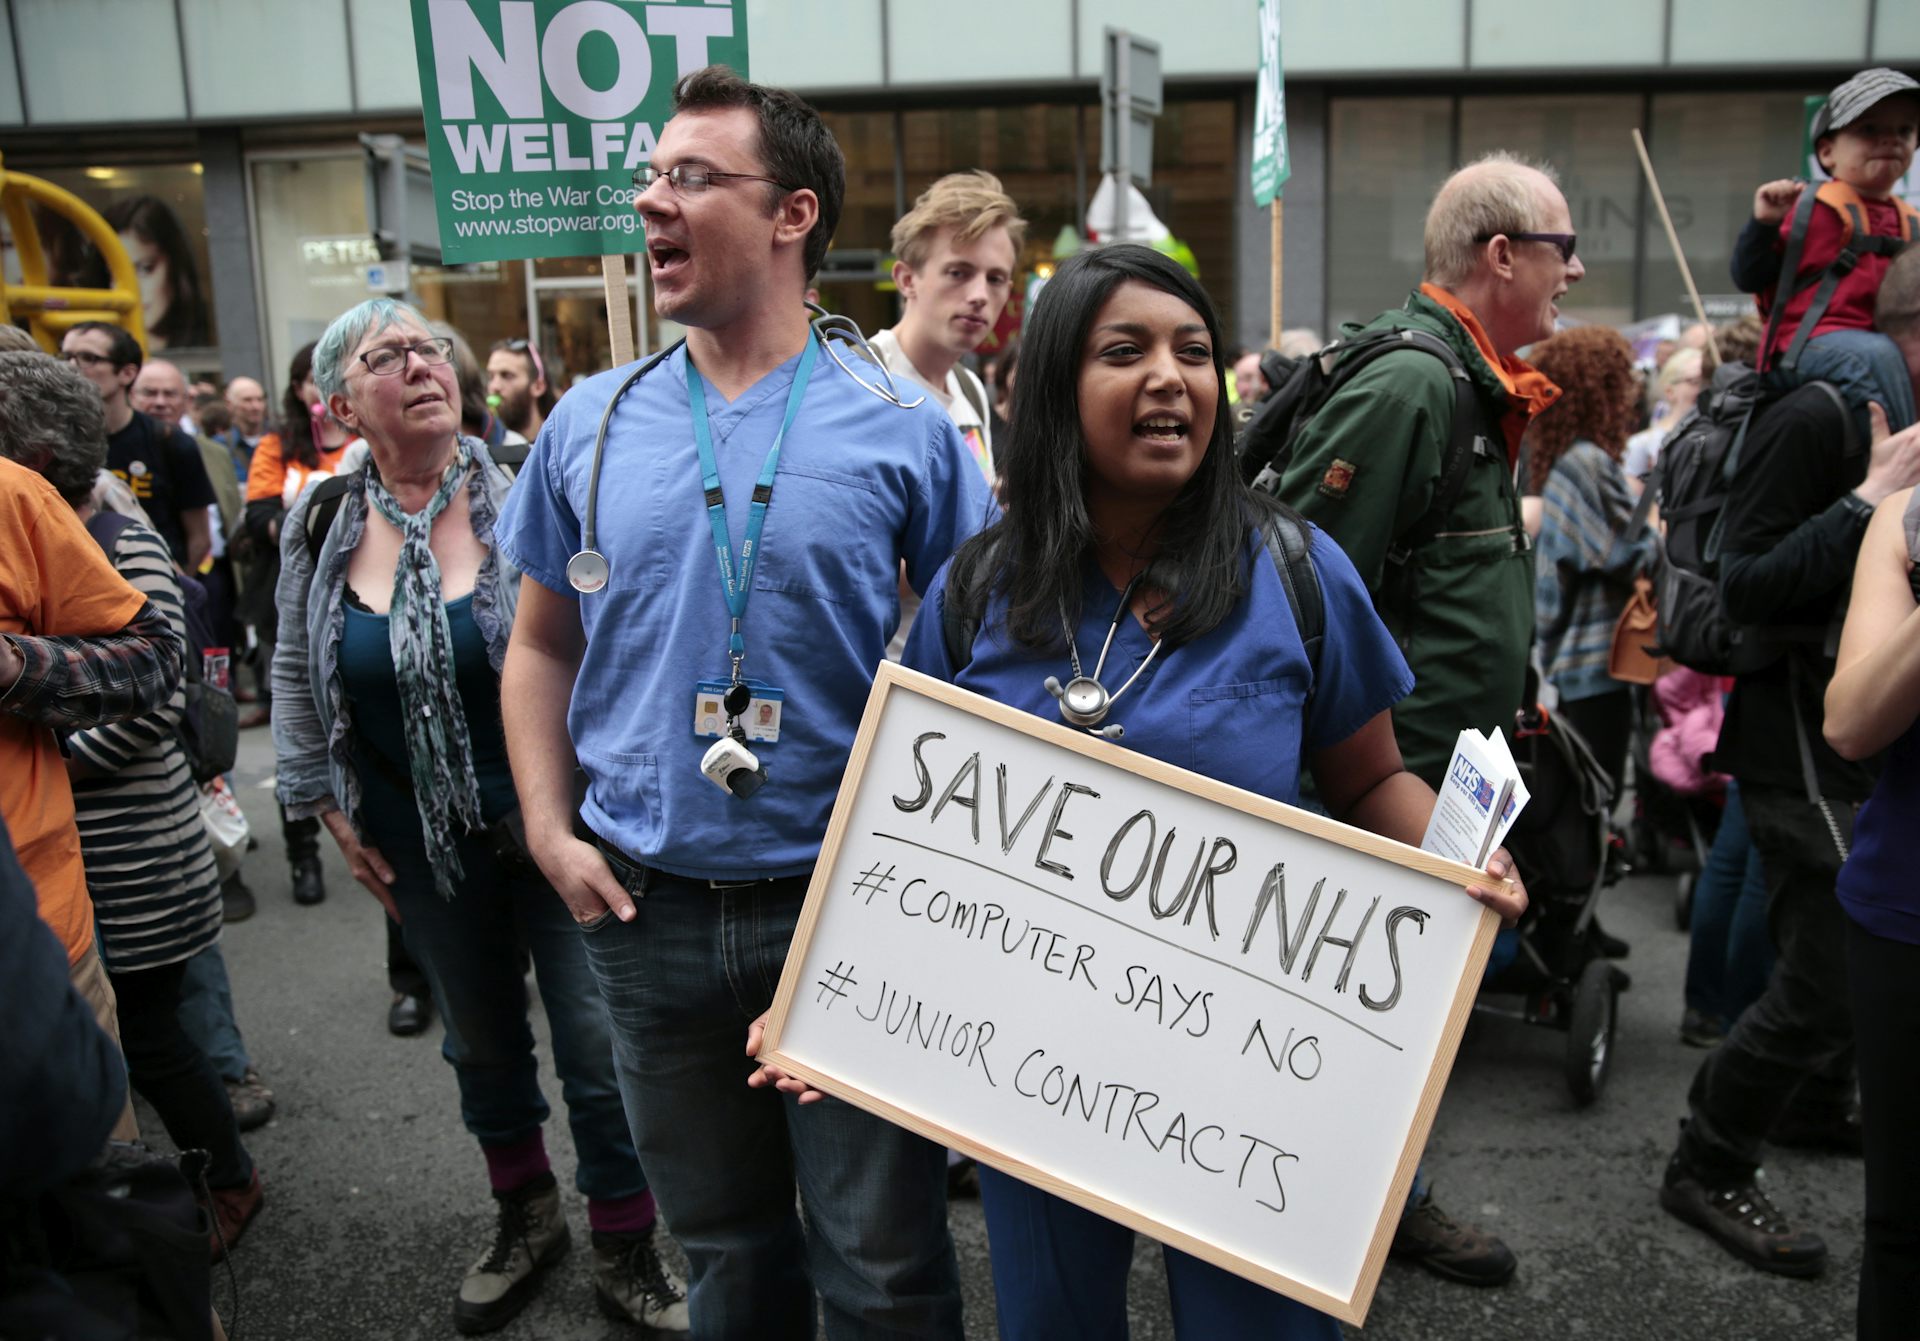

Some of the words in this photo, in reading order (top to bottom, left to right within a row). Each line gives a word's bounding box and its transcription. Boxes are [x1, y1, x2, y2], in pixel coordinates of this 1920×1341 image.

[428, 0, 734, 121] NOT
[443, 121, 668, 175] WELFA
[451, 189, 504, 215] Stop
[508, 188, 544, 209] the
[548, 186, 591, 207] War
[596, 184, 638, 205] Coa
[1453, 756, 1481, 792] NHS
[892, 731, 1101, 882] SAVE
[1100, 809, 1237, 942] OUR
[1241, 862, 1431, 1013] NHS
[852, 862, 1098, 991] #COMPUTER
[1115, 966, 1214, 1038] SAYS
[1241, 1019, 1322, 1081] NO
[1015, 1049, 1299, 1213] CONTRACTS
